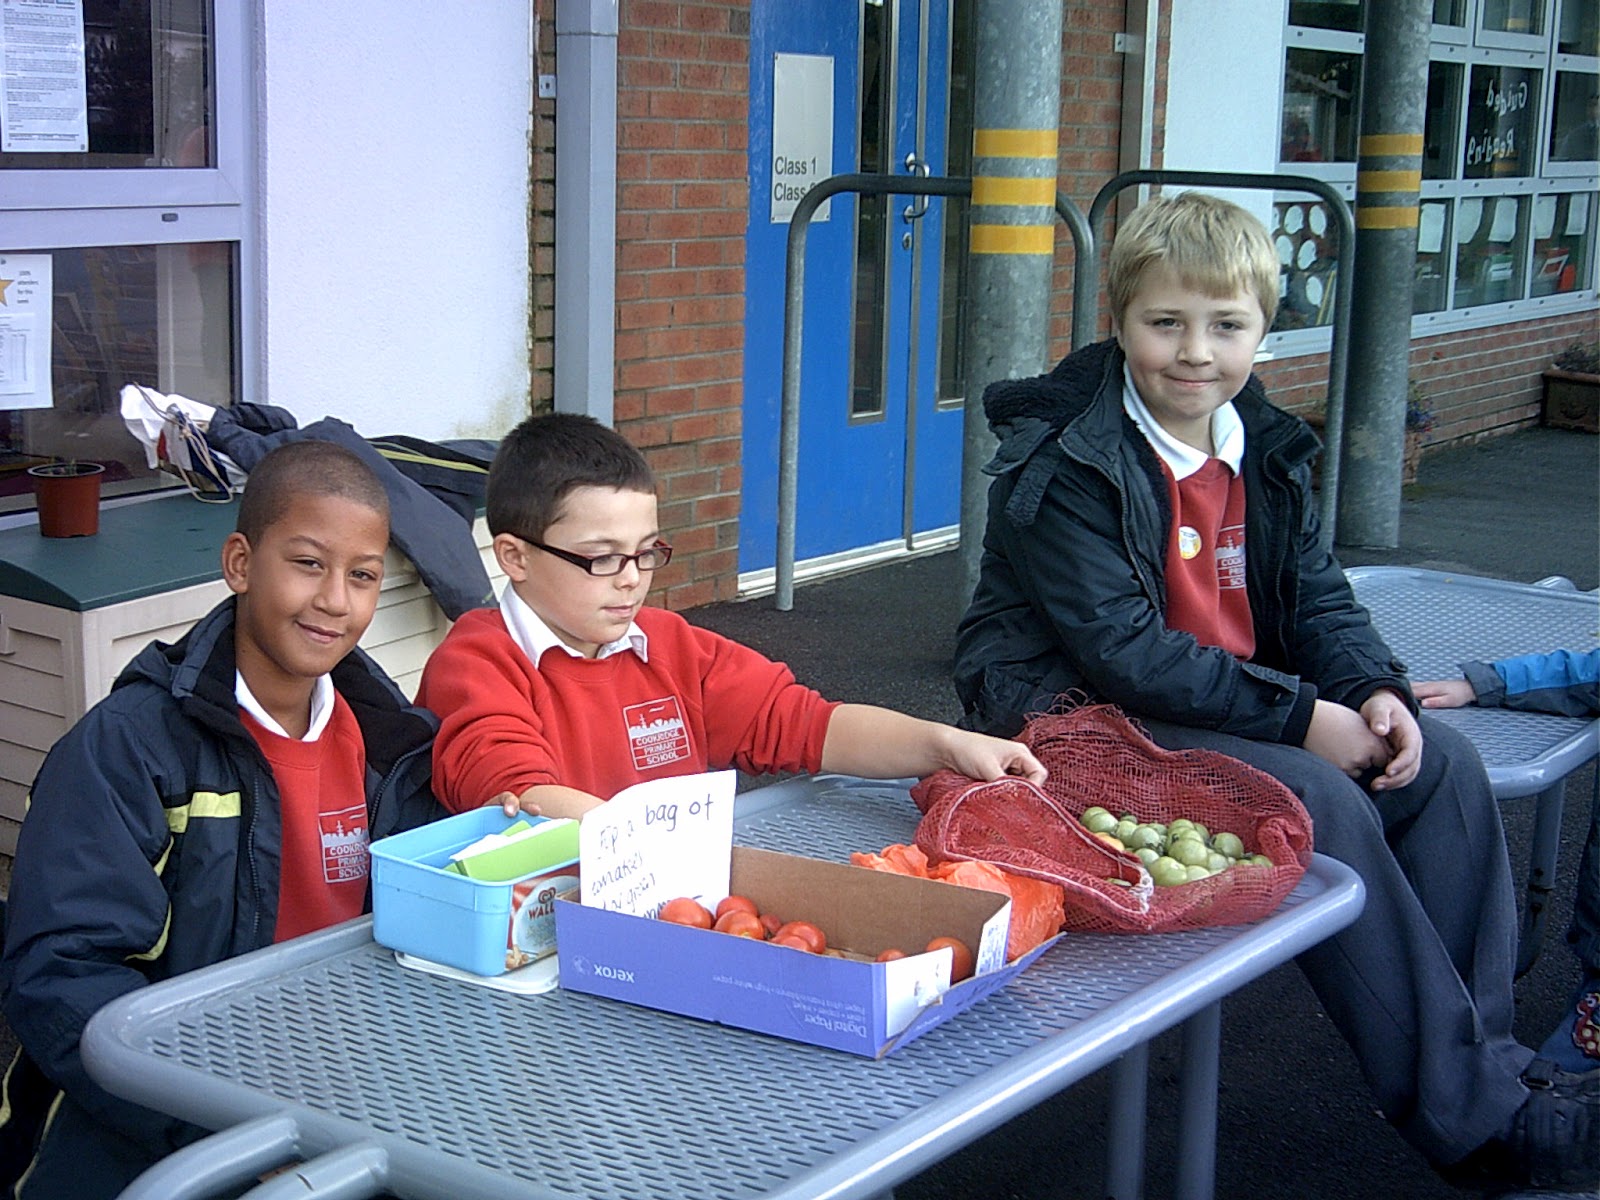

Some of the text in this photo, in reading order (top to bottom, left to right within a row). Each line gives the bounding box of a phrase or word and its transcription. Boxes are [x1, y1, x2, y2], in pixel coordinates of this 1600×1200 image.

[774, 156, 817, 175] Class 1
[773, 182, 807, 202] Class
[636, 728, 680, 746] COOKRIDGE
[643, 740, 677, 756] PRIMARY
[646, 750, 679, 765] SCHOOL
[645, 803, 679, 832] bag
[528, 903, 555, 919] WALL
[593, 964, 635, 984] xerox
[804, 1011, 867, 1038] Digital Paper
